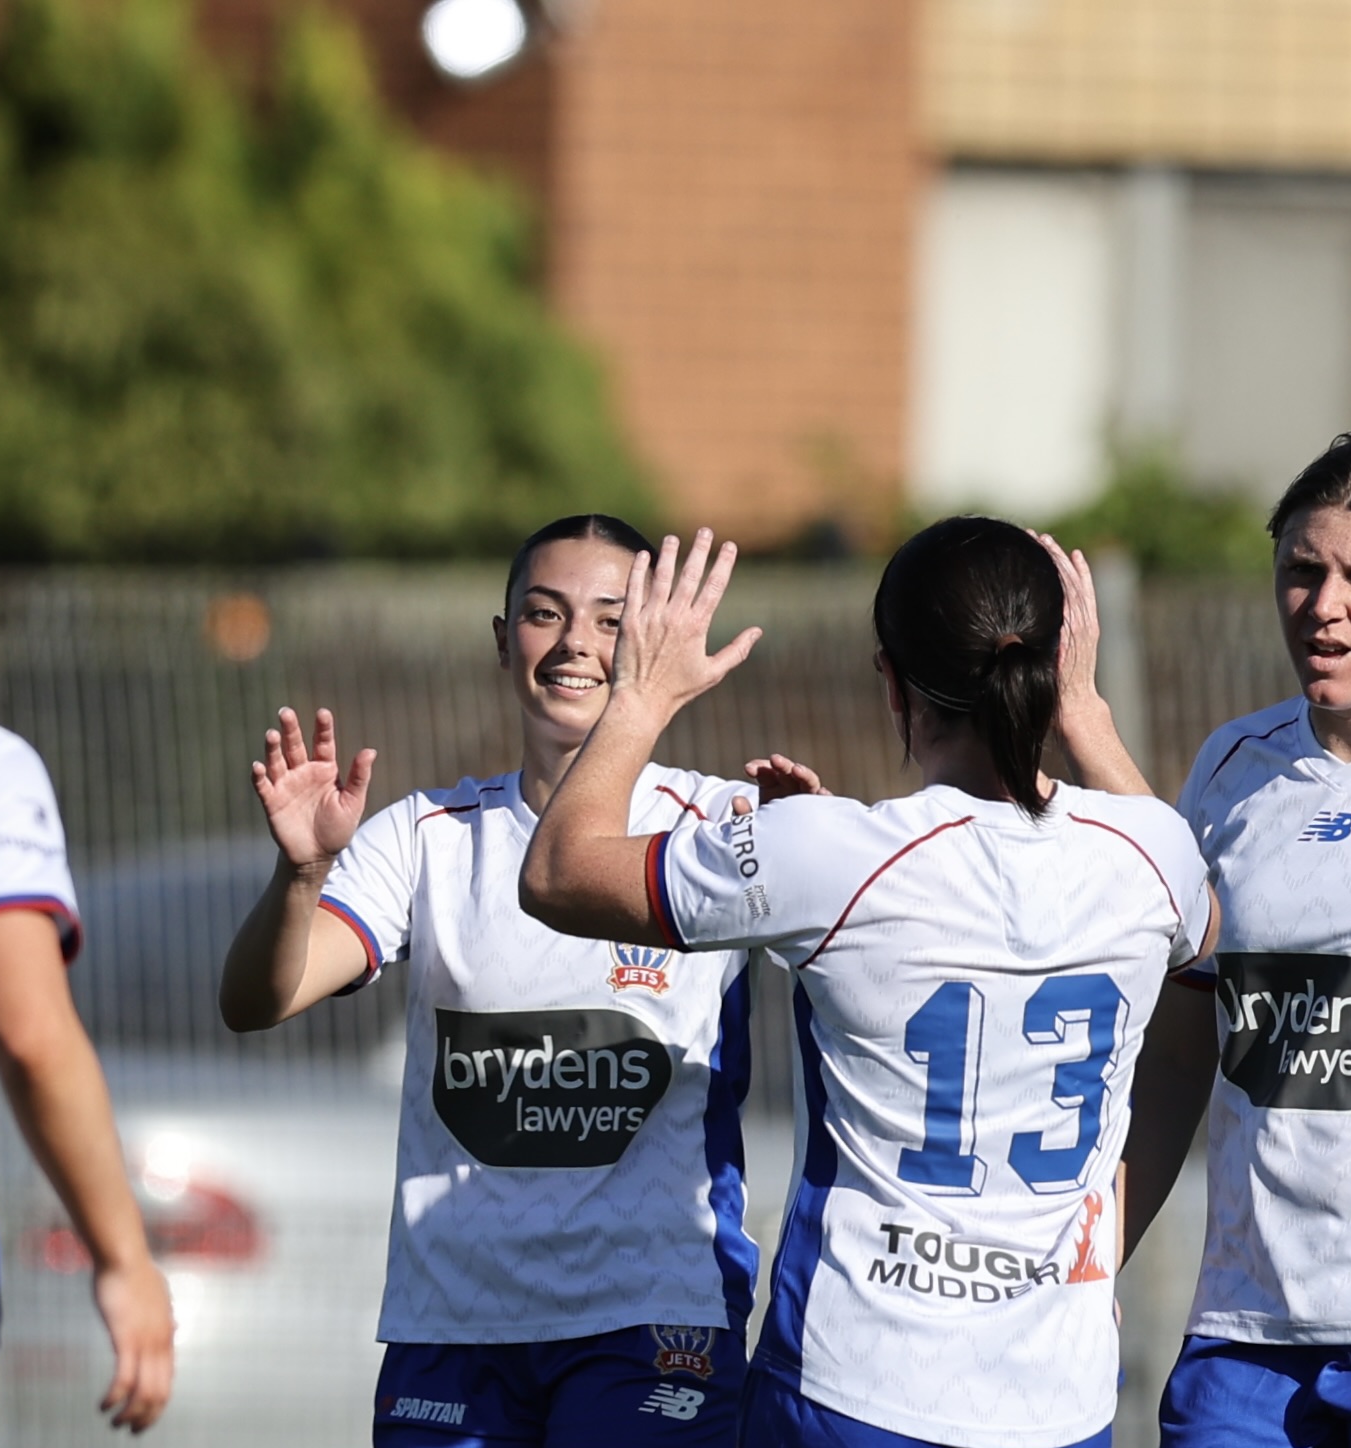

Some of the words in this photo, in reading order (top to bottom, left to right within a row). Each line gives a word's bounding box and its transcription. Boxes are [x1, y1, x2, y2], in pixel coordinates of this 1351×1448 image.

[620, 969, 659, 985] JETS
[444, 1035, 651, 1103] brydens
[897, 973, 1130, 1197] 13
[516, 1097, 645, 1142] lawyers
[666, 1353, 702, 1369] JETS
[390, 1397, 466, 1425] SPARTAN
